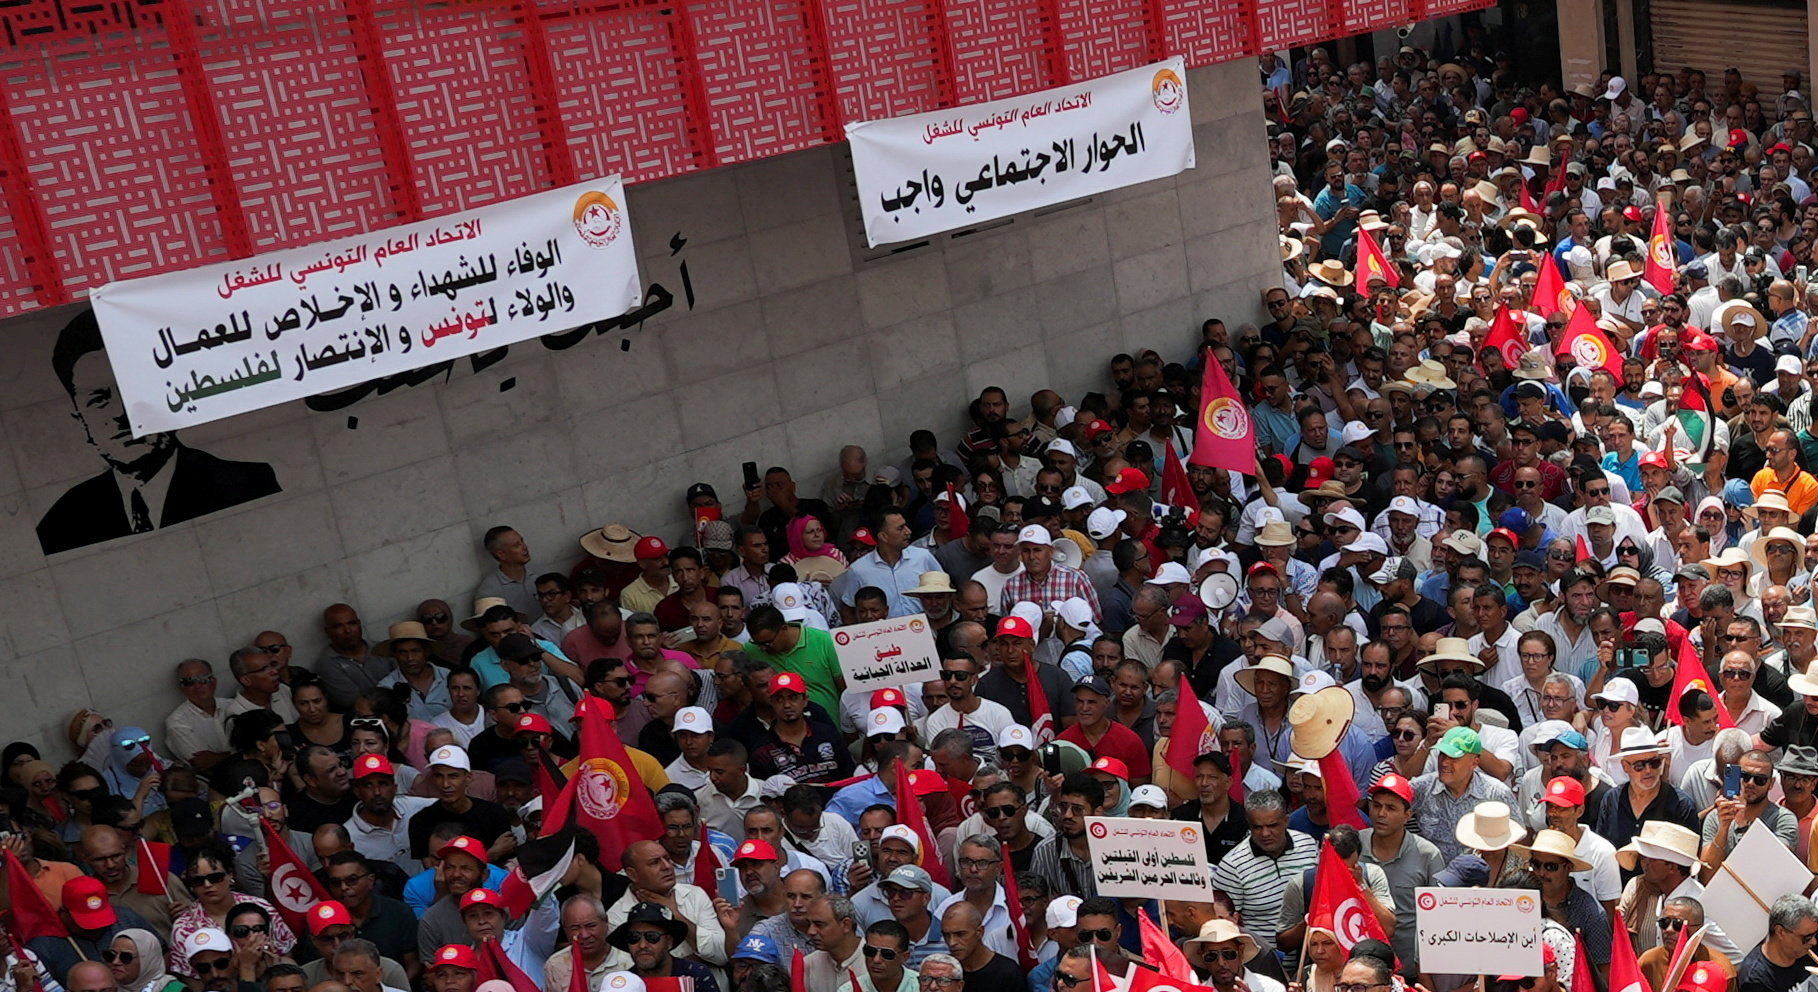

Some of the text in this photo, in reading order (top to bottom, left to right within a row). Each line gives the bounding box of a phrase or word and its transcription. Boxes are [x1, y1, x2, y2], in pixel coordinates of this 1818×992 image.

[922, 92, 1092, 144] الاتحاد العام التونسي للشغل
[880, 121, 1145, 223] الحوار الاجتماعي واجب
[217, 218, 483, 300] الاتحاد العام التونسي للشغل
[153, 238, 562, 369] الوفاء للشهداء و الإخلاص للعمال
[508, 281, 575, 321] والولاء
[399, 324, 412, 353] و
[421, 297, 497, 347] لتونس
[293, 324, 390, 381] الإنتصار
[166, 350, 283, 413] لفلسطين
[895, 656, 932, 674] العدالة
[1101, 849, 1140, 866] القبلتين
[1161, 852, 1197, 868] فلسطين
[1097, 866, 1207, 889] وثالث الحرمين الشريفين
[1428, 930, 1461, 946] الكبرى
[1464, 931, 1518, 949] الإصلاحات
[1521, 928, 1537, 948] أين
